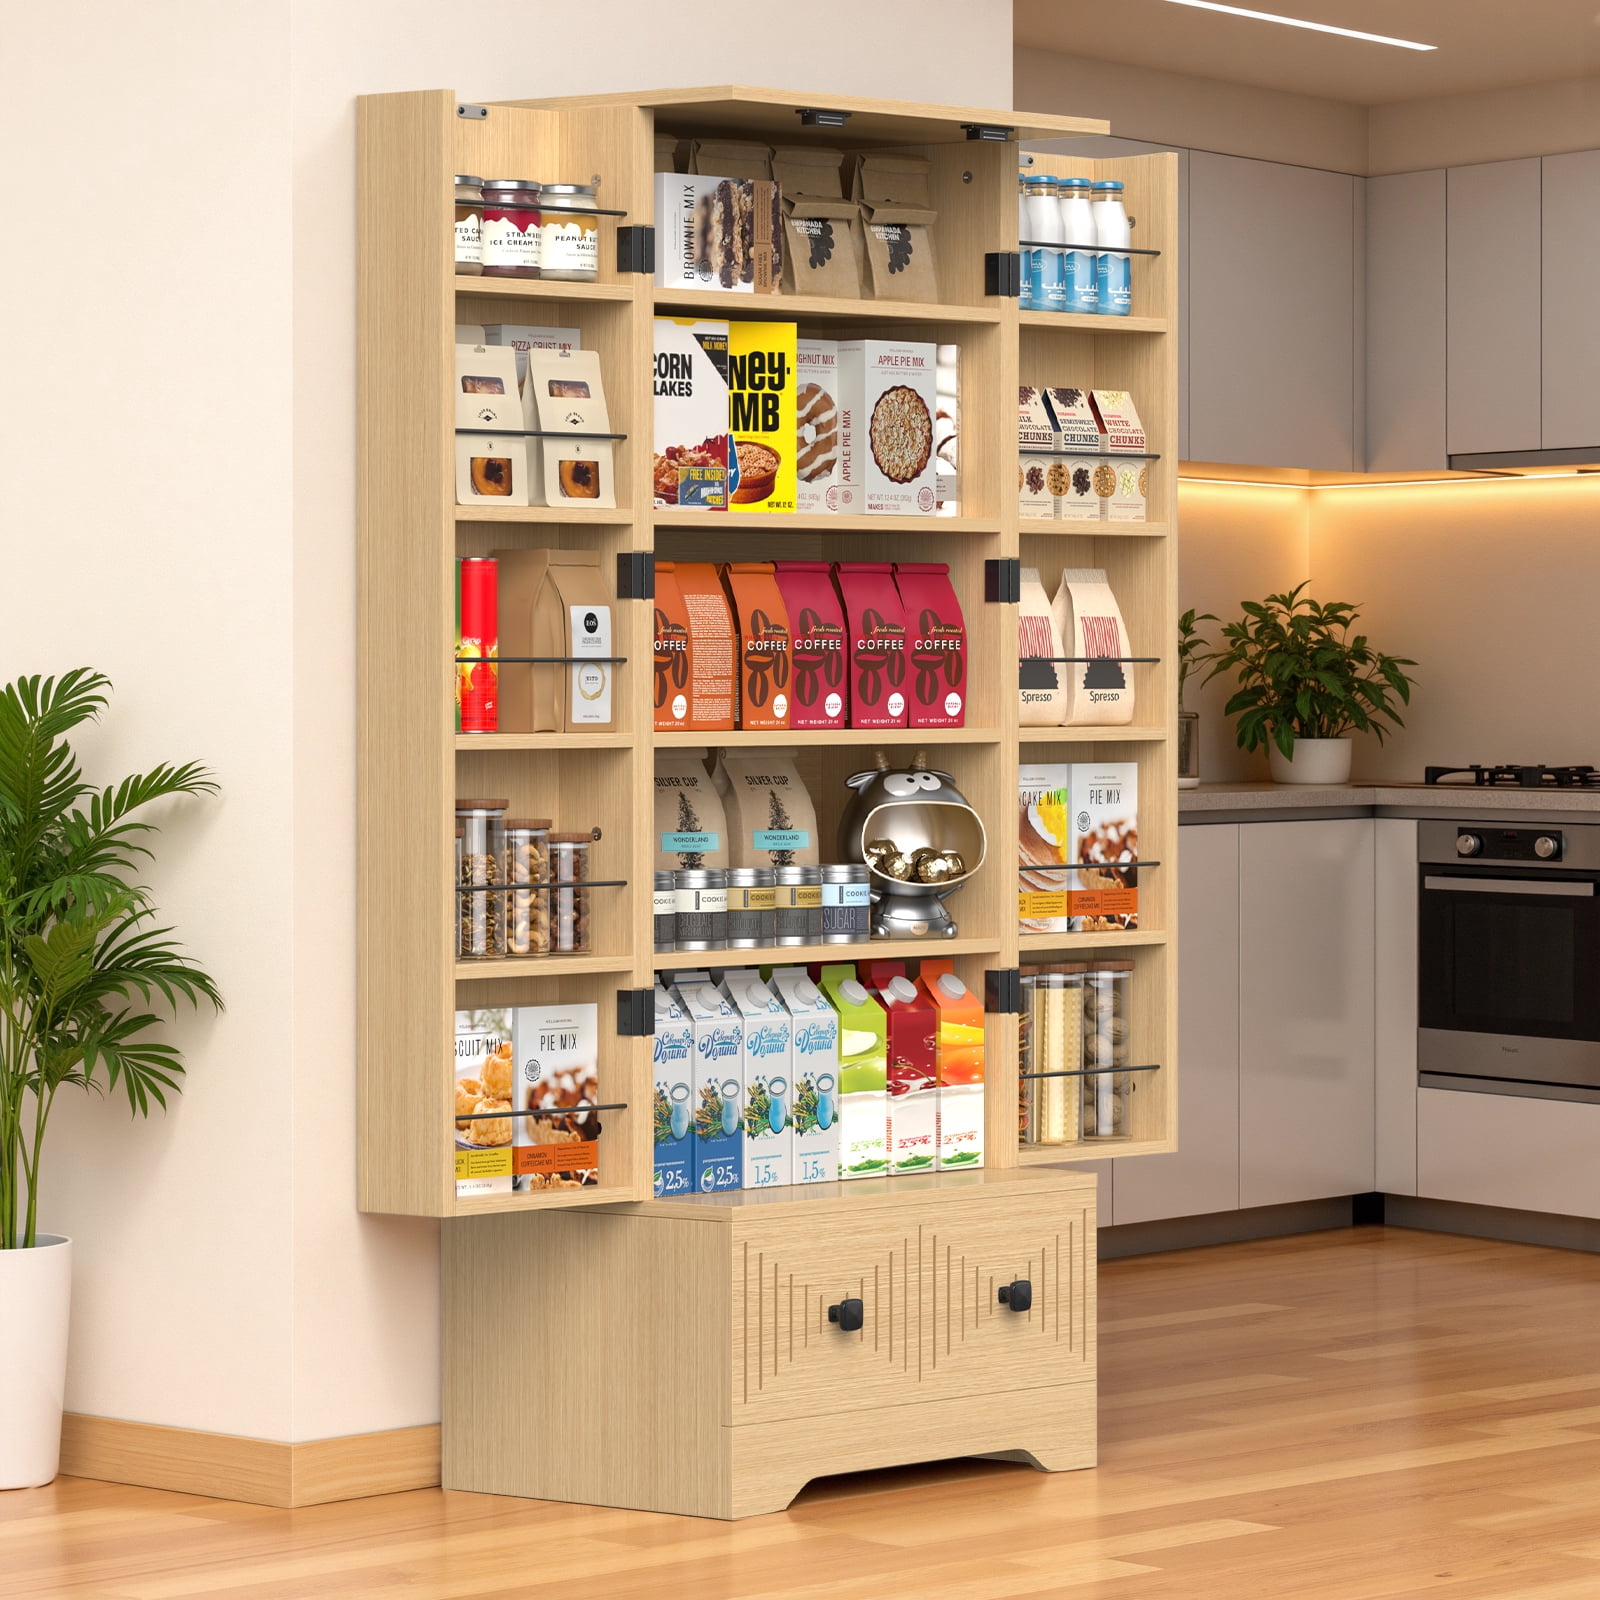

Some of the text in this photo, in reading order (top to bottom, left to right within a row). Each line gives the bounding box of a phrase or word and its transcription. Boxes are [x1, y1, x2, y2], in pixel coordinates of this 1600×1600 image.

[683, 184, 695, 280] BROWNIE MIX
[796, 226, 821, 236] KITCHEN
[875, 232, 900, 241] KITCHEN
[511, 340, 531, 351] PIZZA
[532, 341, 557, 350] CRUST
[822, 355, 835, 365] MIX
[878, 355, 925, 367] APPLE PIE MIX
[729, 392, 780, 433] MB
[1105, 419, 1131, 427] WHITE
[1108, 427, 1144, 435] CHOCOLATE
[1064, 433, 1099, 443] CHUNKS
[1110, 435, 1145, 445] CHUNKS
[843, 410, 851, 482] APPLE PIE MIX
[690, 468, 703, 480] FREE
[747, 640, 787, 651] COFFEE
[794, 639, 841, 650] COFFEE
[857, 639, 904, 650] COFFEE
[914, 639, 961, 650] COFFEE
[1021, 690, 1052, 704] Spresso
[1089, 690, 1120, 704] Spresso
[654, 777, 698, 787] SILVER CUP
[745, 775, 789, 786] SILVER CUP
[1046, 790, 1061, 805] MIX
[1089, 789, 1121, 805] PIE MIX
[823, 907, 856, 929] SUGAR
[485, 1038, 503, 1055] MIX
[540, 1033, 577, 1052] PIE MIX
